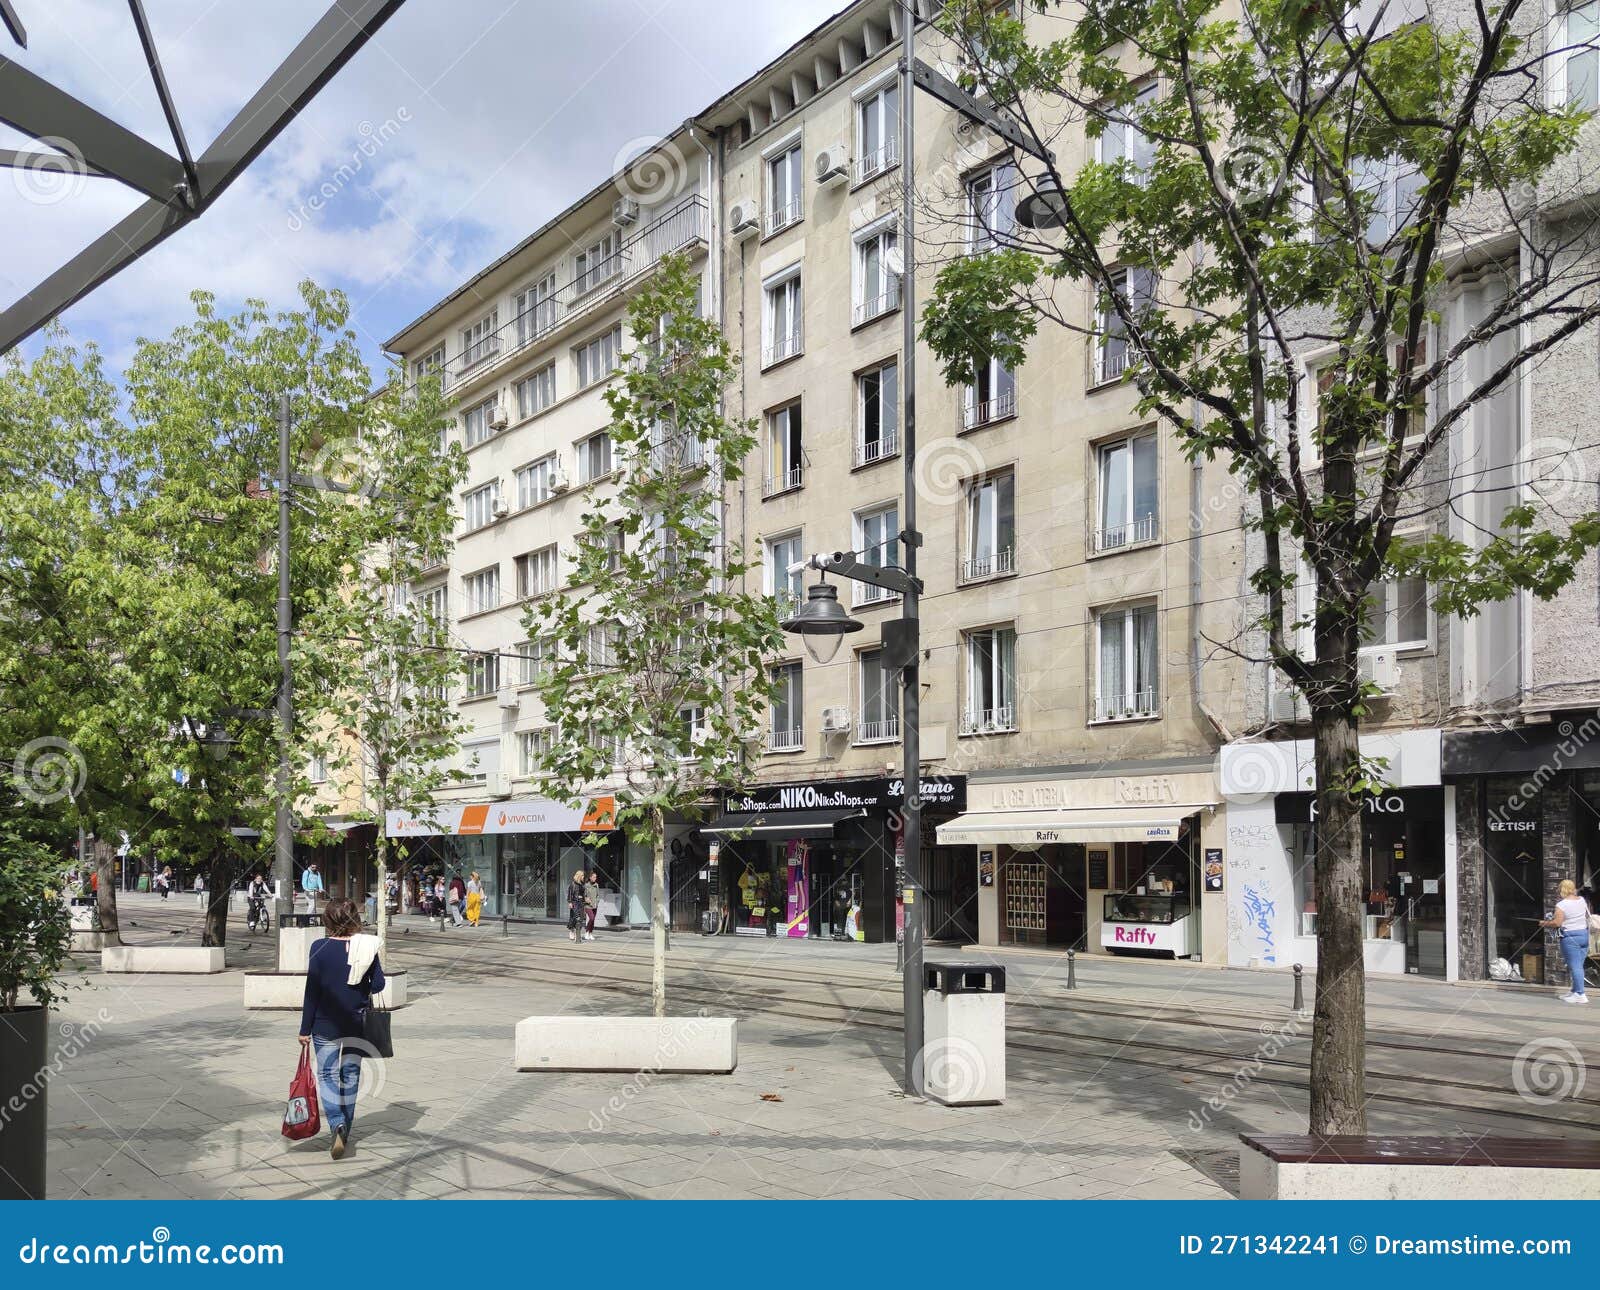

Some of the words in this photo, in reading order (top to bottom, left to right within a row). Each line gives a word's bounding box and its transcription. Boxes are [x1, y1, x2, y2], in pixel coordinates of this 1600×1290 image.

[887, 780, 956, 797] Luiano
[780, 787, 816, 809] NIKO
[508, 814, 546, 824] VIVACOM
[1491, 821, 1536, 832] FETISH
[1036, 831, 1059, 841] Raffy
[1115, 926, 1156, 945] Raffy
